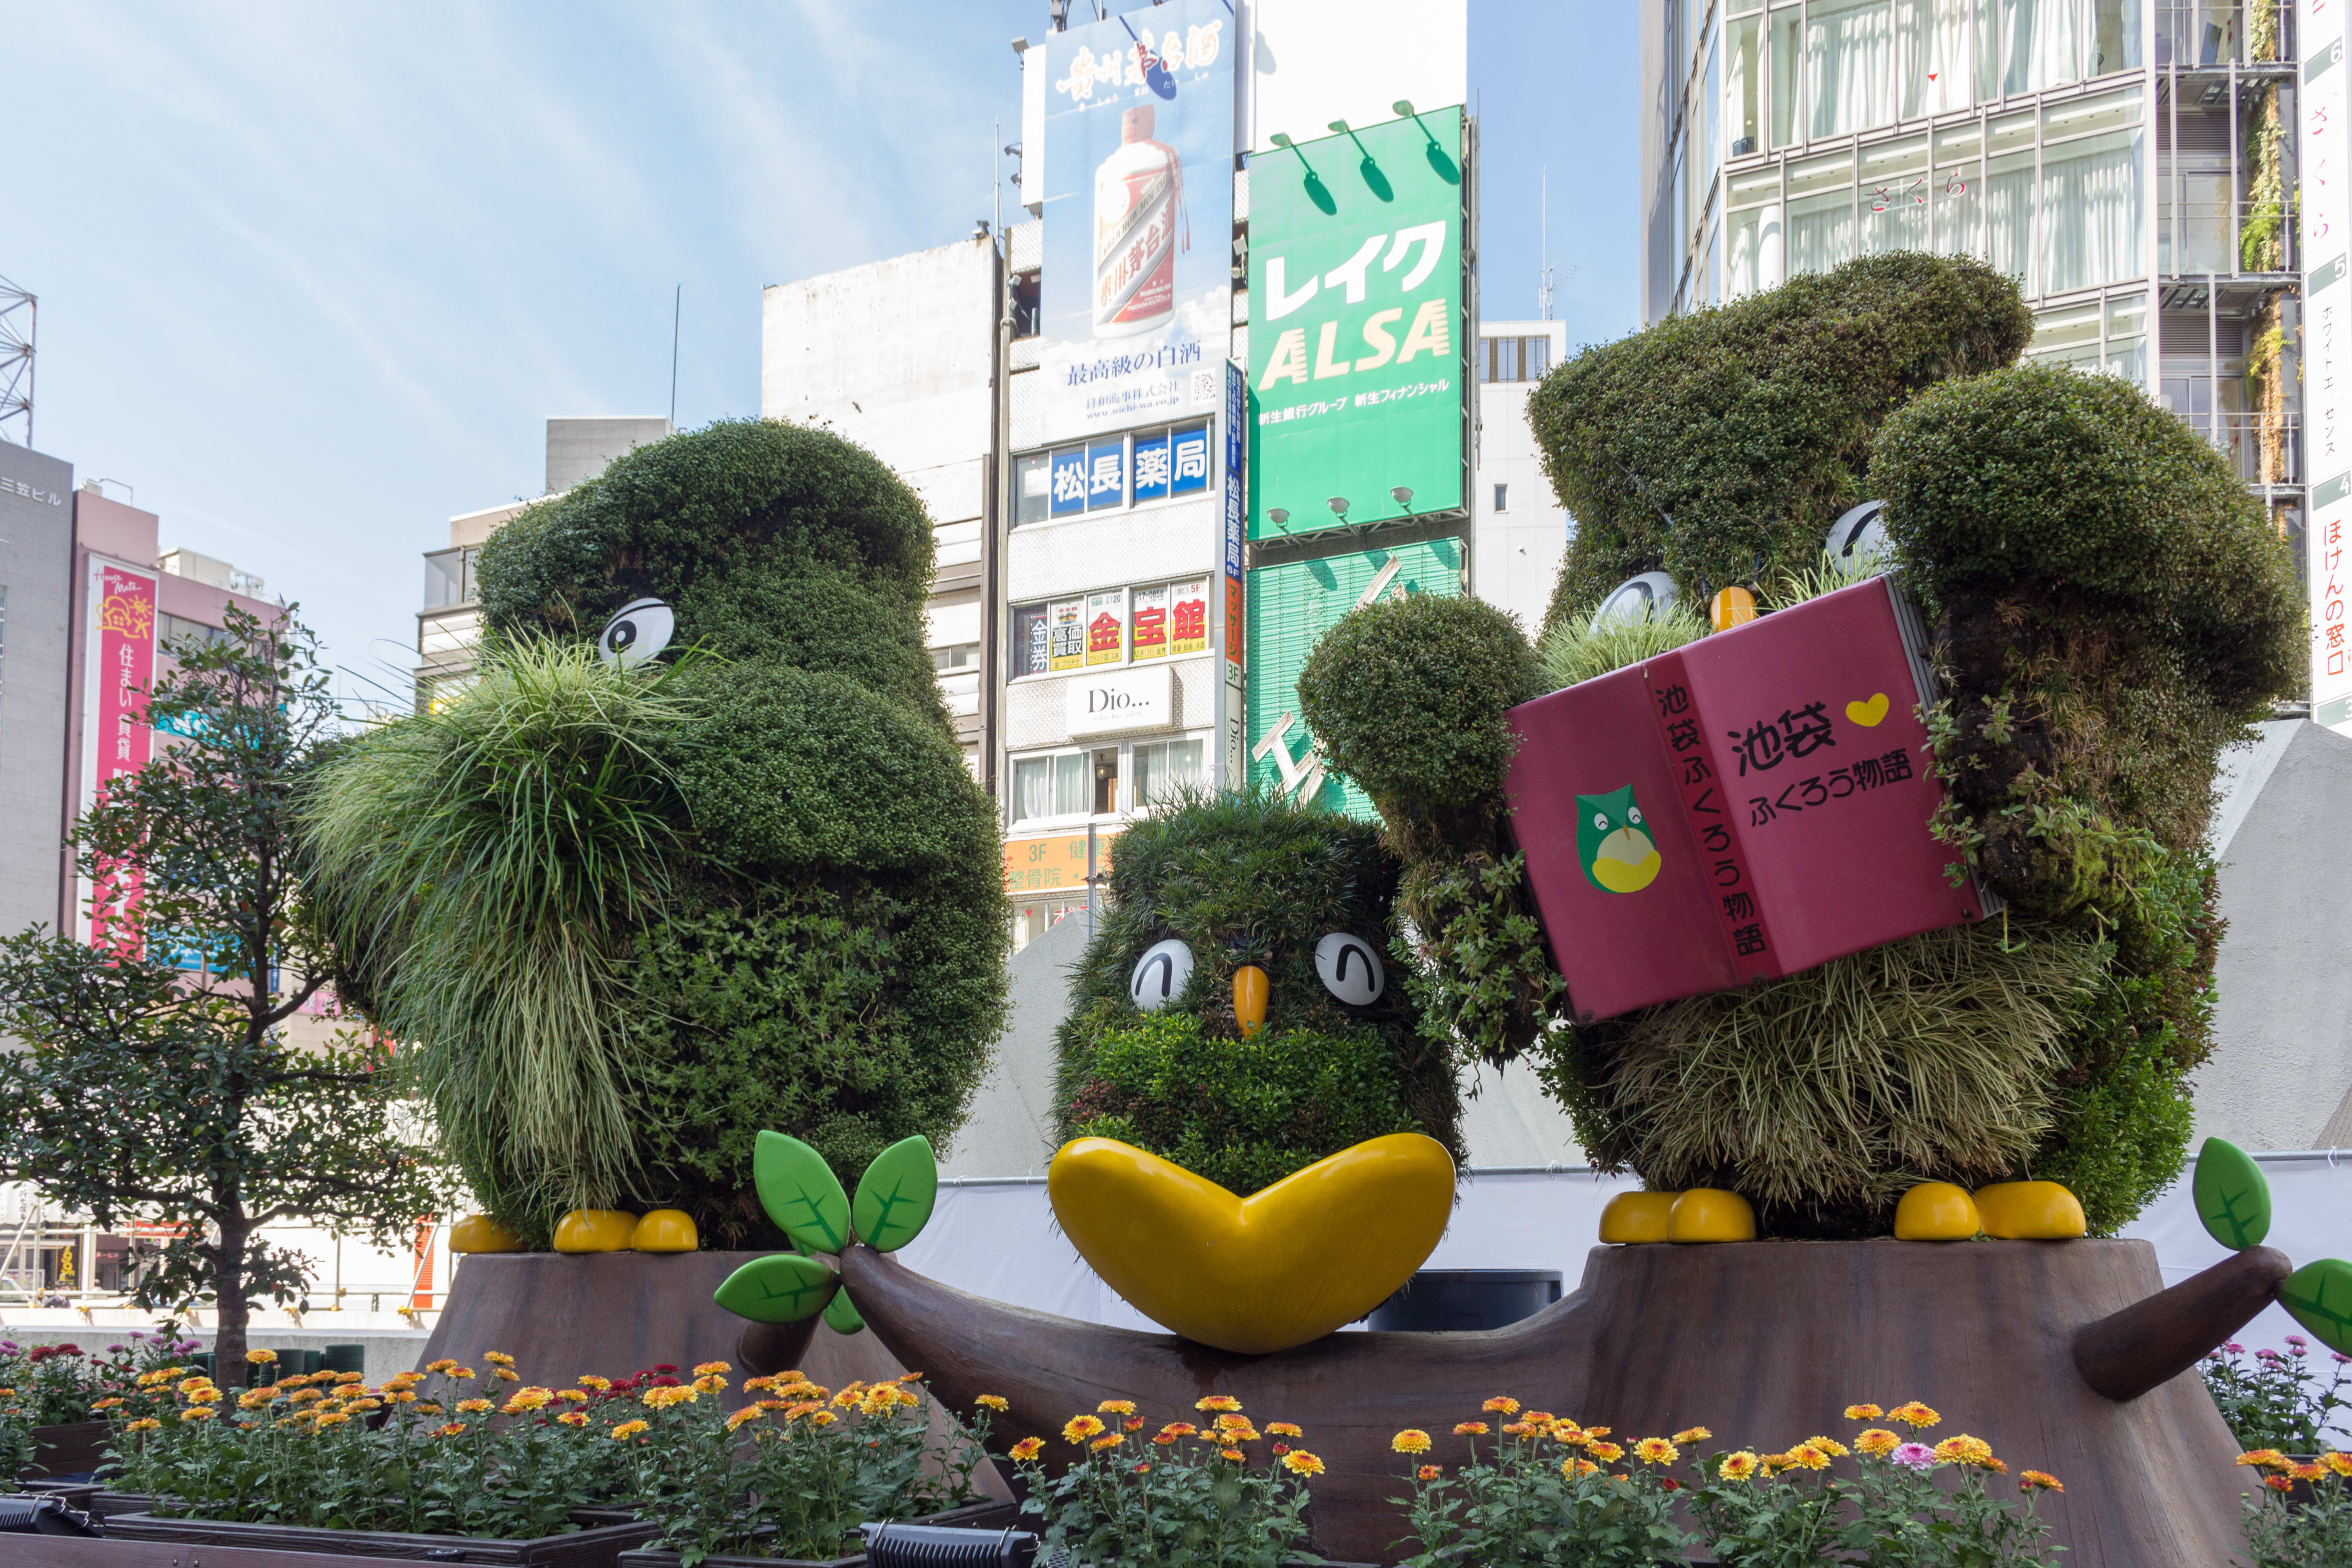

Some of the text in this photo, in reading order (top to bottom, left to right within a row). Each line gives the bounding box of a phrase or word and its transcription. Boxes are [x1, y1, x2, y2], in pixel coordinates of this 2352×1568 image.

[2331, 42, 2342, 64] 6
[1864, 170, 1966, 212] さくら
[2310, 106, 2329, 239] さくら
[1265, 219, 1446, 322] レイク
[2334, 255, 2346, 278] 5
[1068, 339, 1201, 386] 最高級の白酒
[1257, 297, 1450, 392] ALSA
[1258, 378, 1450, 426] 新生銀行グループ 新生フィナンシャル
[0, 477, 61, 507] 三笠ビル
[1053, 439, 1207, 503] 松長薬局
[2339, 476, 2350, 495] 4
[1226, 473, 1240, 578] 松長薬局 6F
[1106, 594, 1121, 605] 0120
[1191, 583, 1201, 593] 5F
[2323, 519, 2345, 676] ほけんの窓口
[1052, 625, 1082, 644] 高価
[1088, 598, 1205, 652] 金宝館
[1229, 584, 1238, 657] マッサージ
[1031, 619, 1048, 671] 金券
[1052, 639, 1082, 658] 買取
[1227, 663, 1239, 683] 3F
[1727, 701, 1836, 777] 池袋
[1748, 747, 1913, 827] ふくろう物語
[1654, 683, 1766, 957] 池袋ふくろう物語
[1028, 843, 1047, 862] 3F
[1008, 867, 1061, 891] 整骨院
